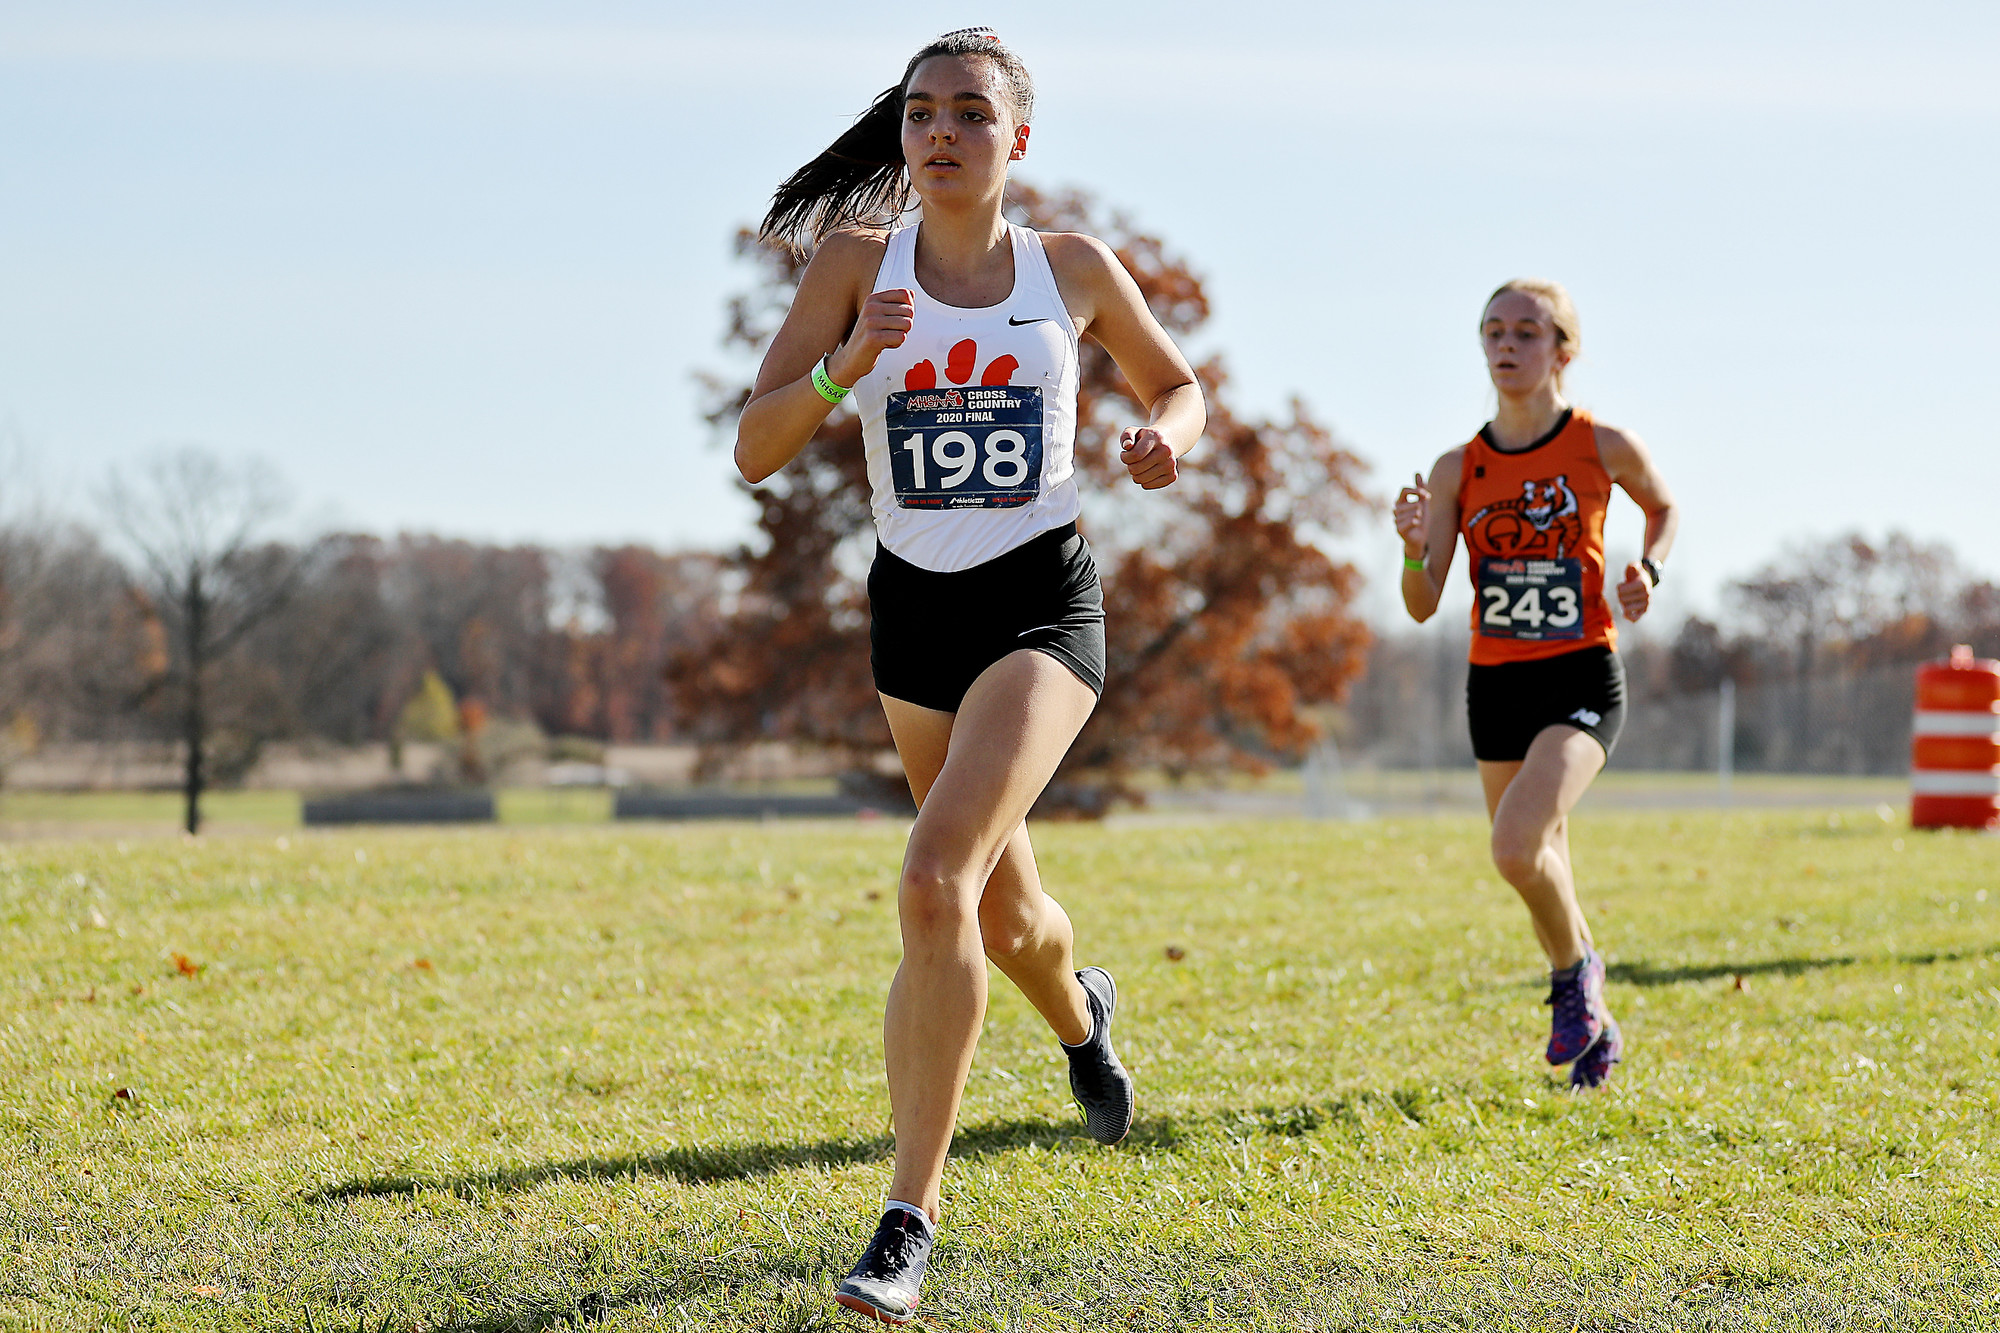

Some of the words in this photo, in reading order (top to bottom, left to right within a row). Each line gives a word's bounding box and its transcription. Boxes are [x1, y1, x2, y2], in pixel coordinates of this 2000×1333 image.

[818, 375, 845, 399] MHSAA
[967, 390, 1007, 400] CROSS
[967, 399, 1022, 410] COUNTRY
[936, 412, 963, 424] 2020
[965, 411, 996, 423] FINAL
[903, 429, 1029, 490] 198
[1482, 585, 1579, 628] 243
